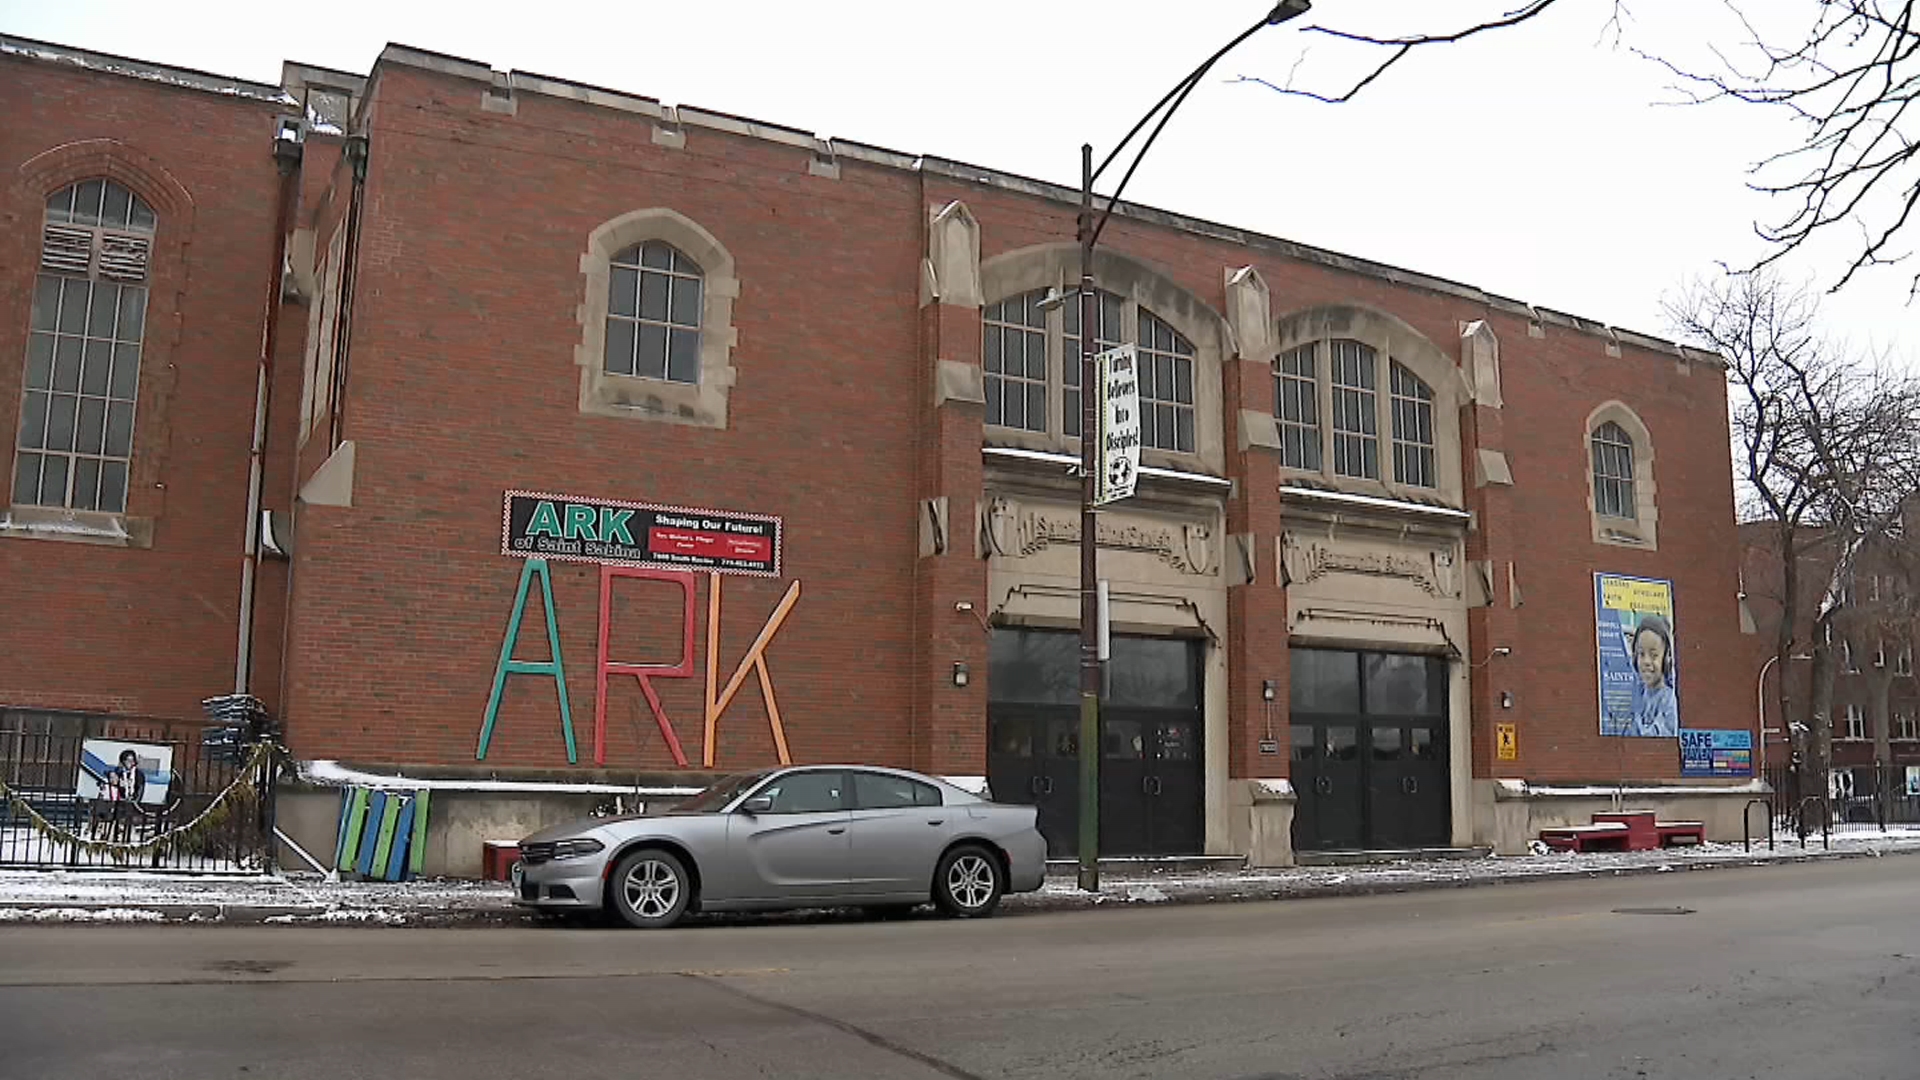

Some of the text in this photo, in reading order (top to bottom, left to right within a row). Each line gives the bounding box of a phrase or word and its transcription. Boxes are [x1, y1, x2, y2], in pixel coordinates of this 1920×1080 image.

[525, 501, 635, 545] ARK
[656, 514, 763, 533] Shaping Our Future!
[514, 536, 640, 559] of Saint Sabina
[475, 558, 800, 768] ARK
[1681, 732, 1712, 747] SAFE
